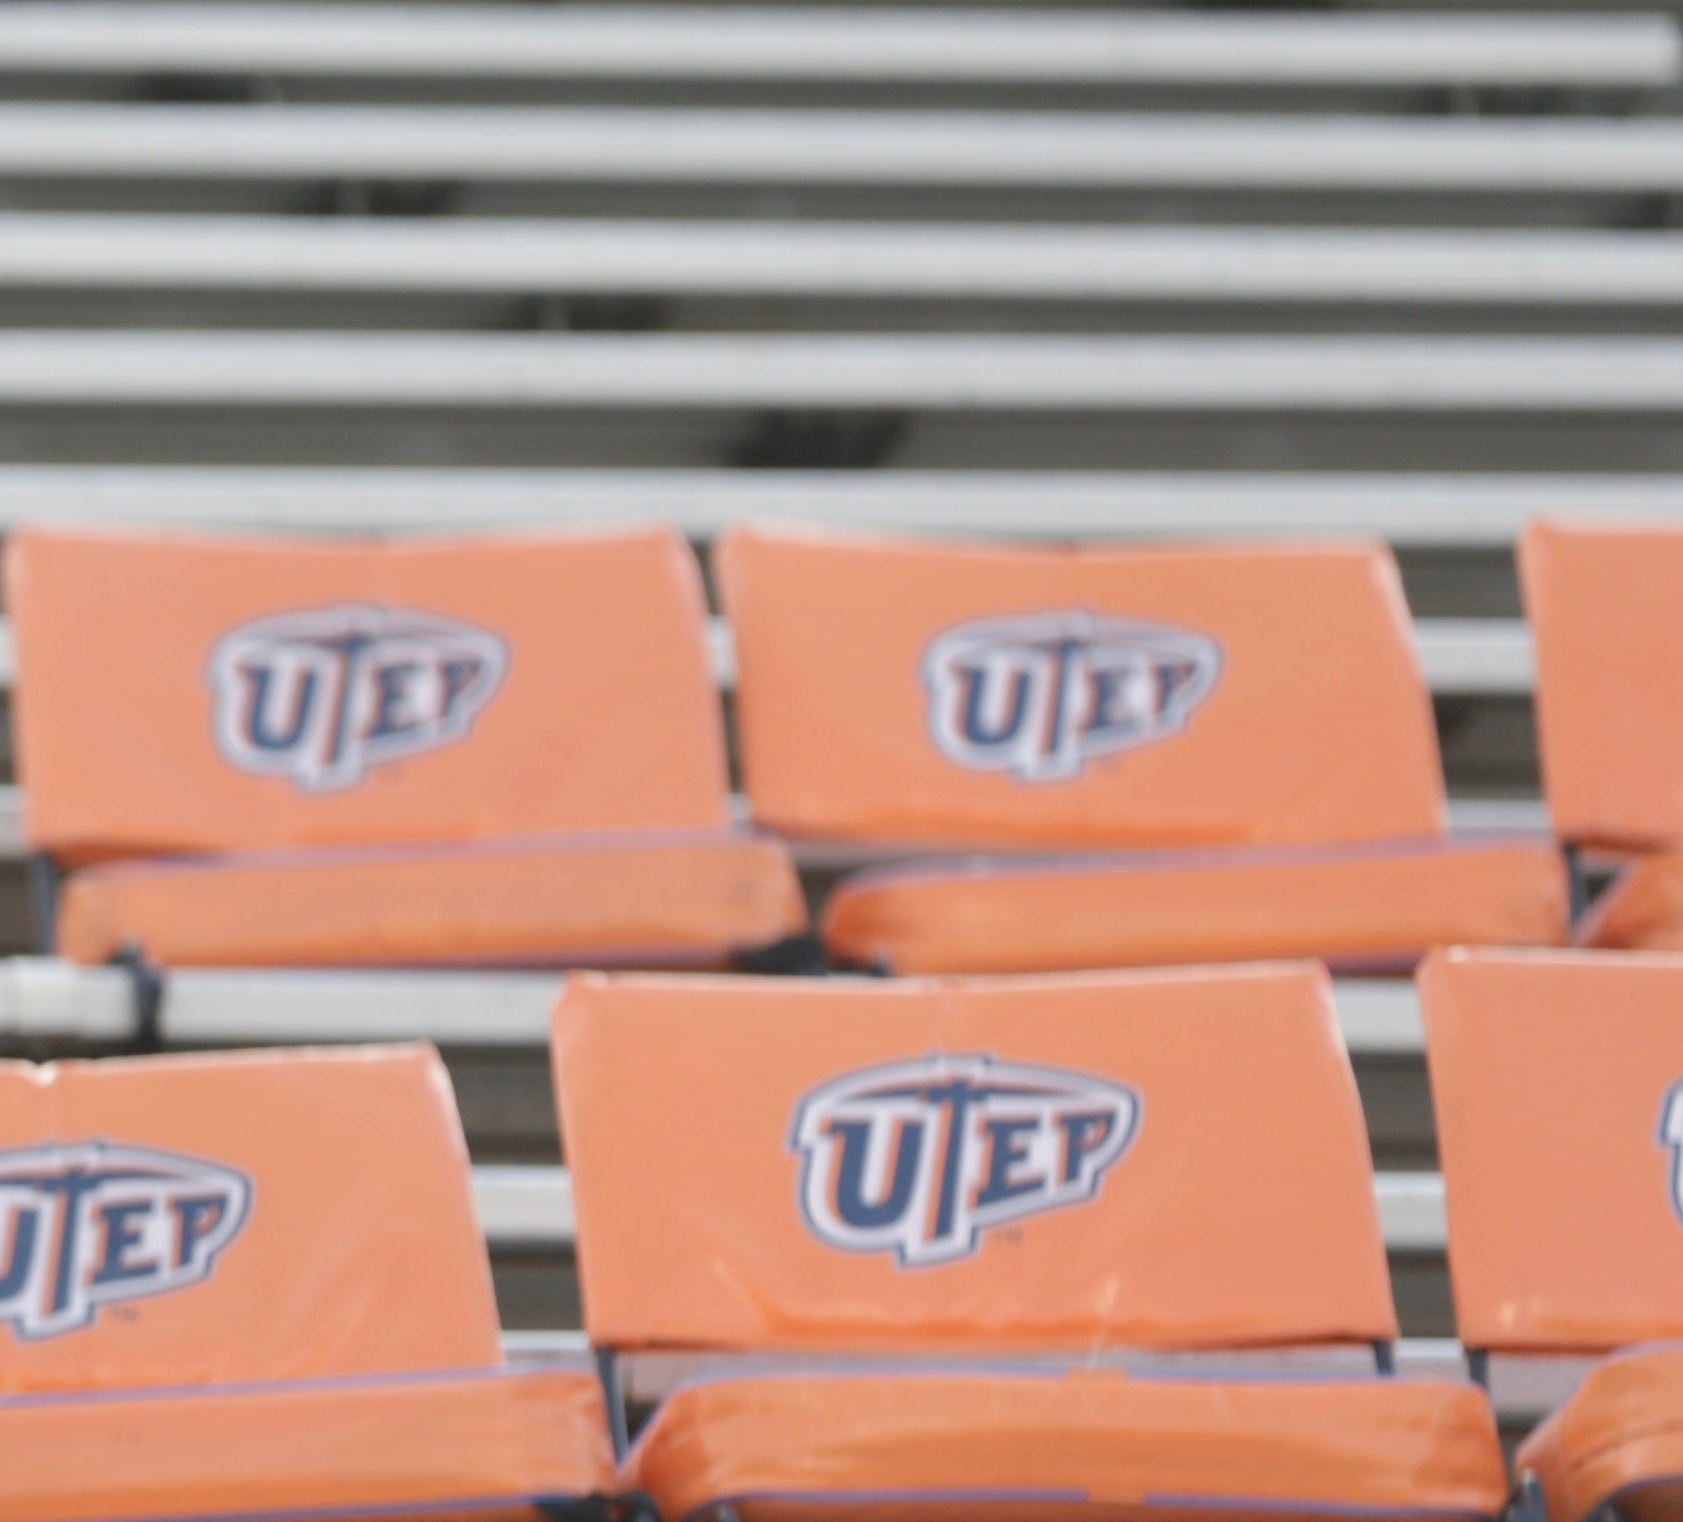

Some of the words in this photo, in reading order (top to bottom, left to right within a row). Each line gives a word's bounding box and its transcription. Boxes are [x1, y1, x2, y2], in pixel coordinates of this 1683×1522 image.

[217, 613, 497, 780] UTEP
[933, 620, 1210, 772] UTEP
[803, 1068, 1131, 1256] UTEP
